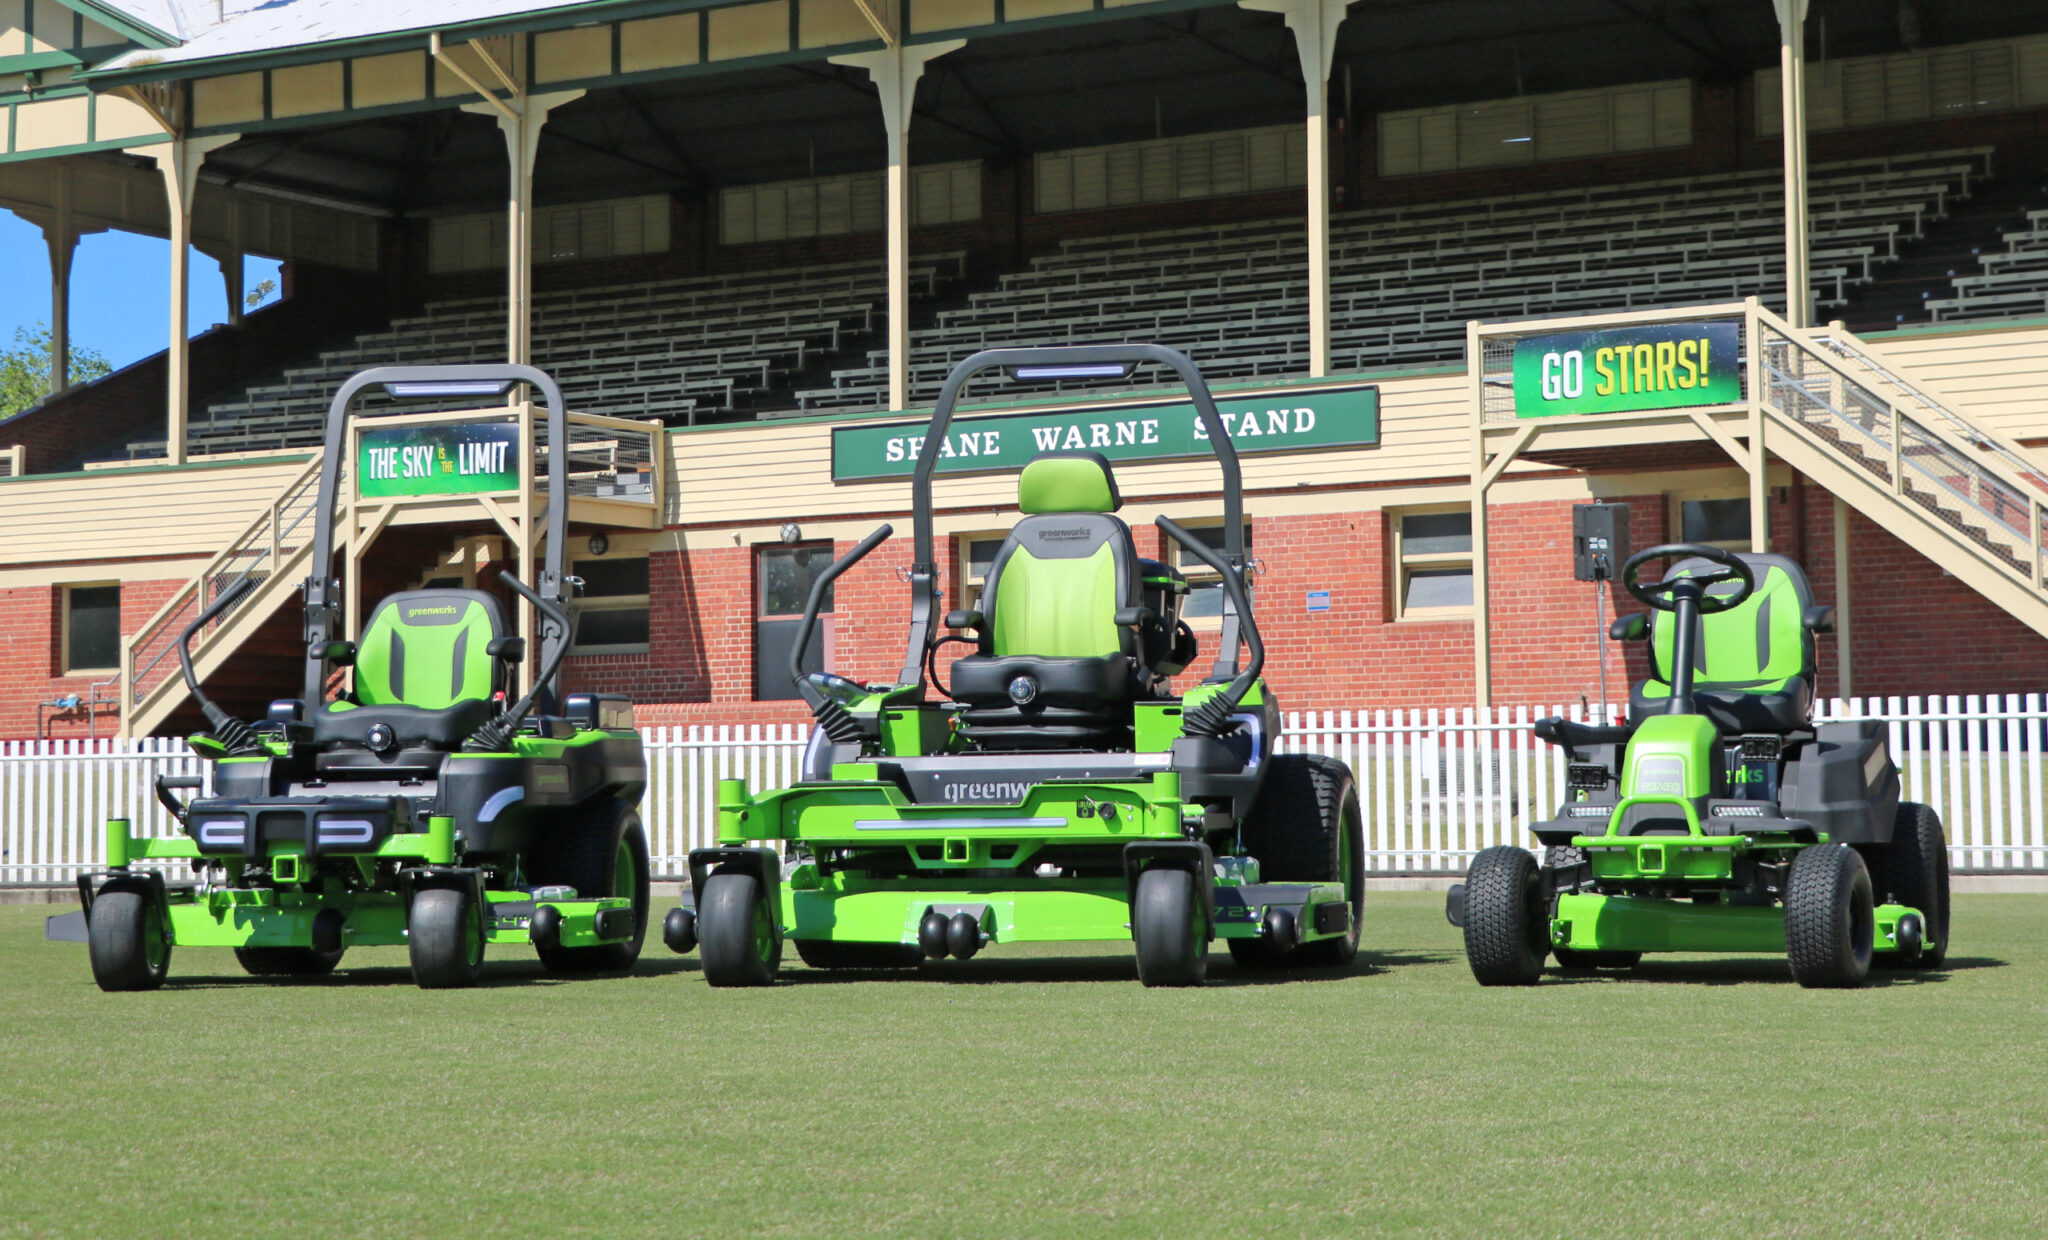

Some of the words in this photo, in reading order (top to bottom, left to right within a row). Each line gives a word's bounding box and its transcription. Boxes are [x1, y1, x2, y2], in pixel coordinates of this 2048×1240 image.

[1541, 349, 1584, 401] GO
[1595, 338, 1709, 396] STARS!
[886, 431, 1000, 462] SHANE
[1031, 419, 1159, 451] WARNE
[1193, 407, 1316, 440] STAND
[369, 447, 399, 480] THE
[402, 445, 434, 478] SKY
[438, 448, 446, 460] IS
[441, 461, 454, 473] THE
[459, 441, 510, 475] LIMIT
[1039, 527, 1091, 539] greenworks
[408, 605, 457, 618] greenworks
[944, 782, 1042, 803] greenw
